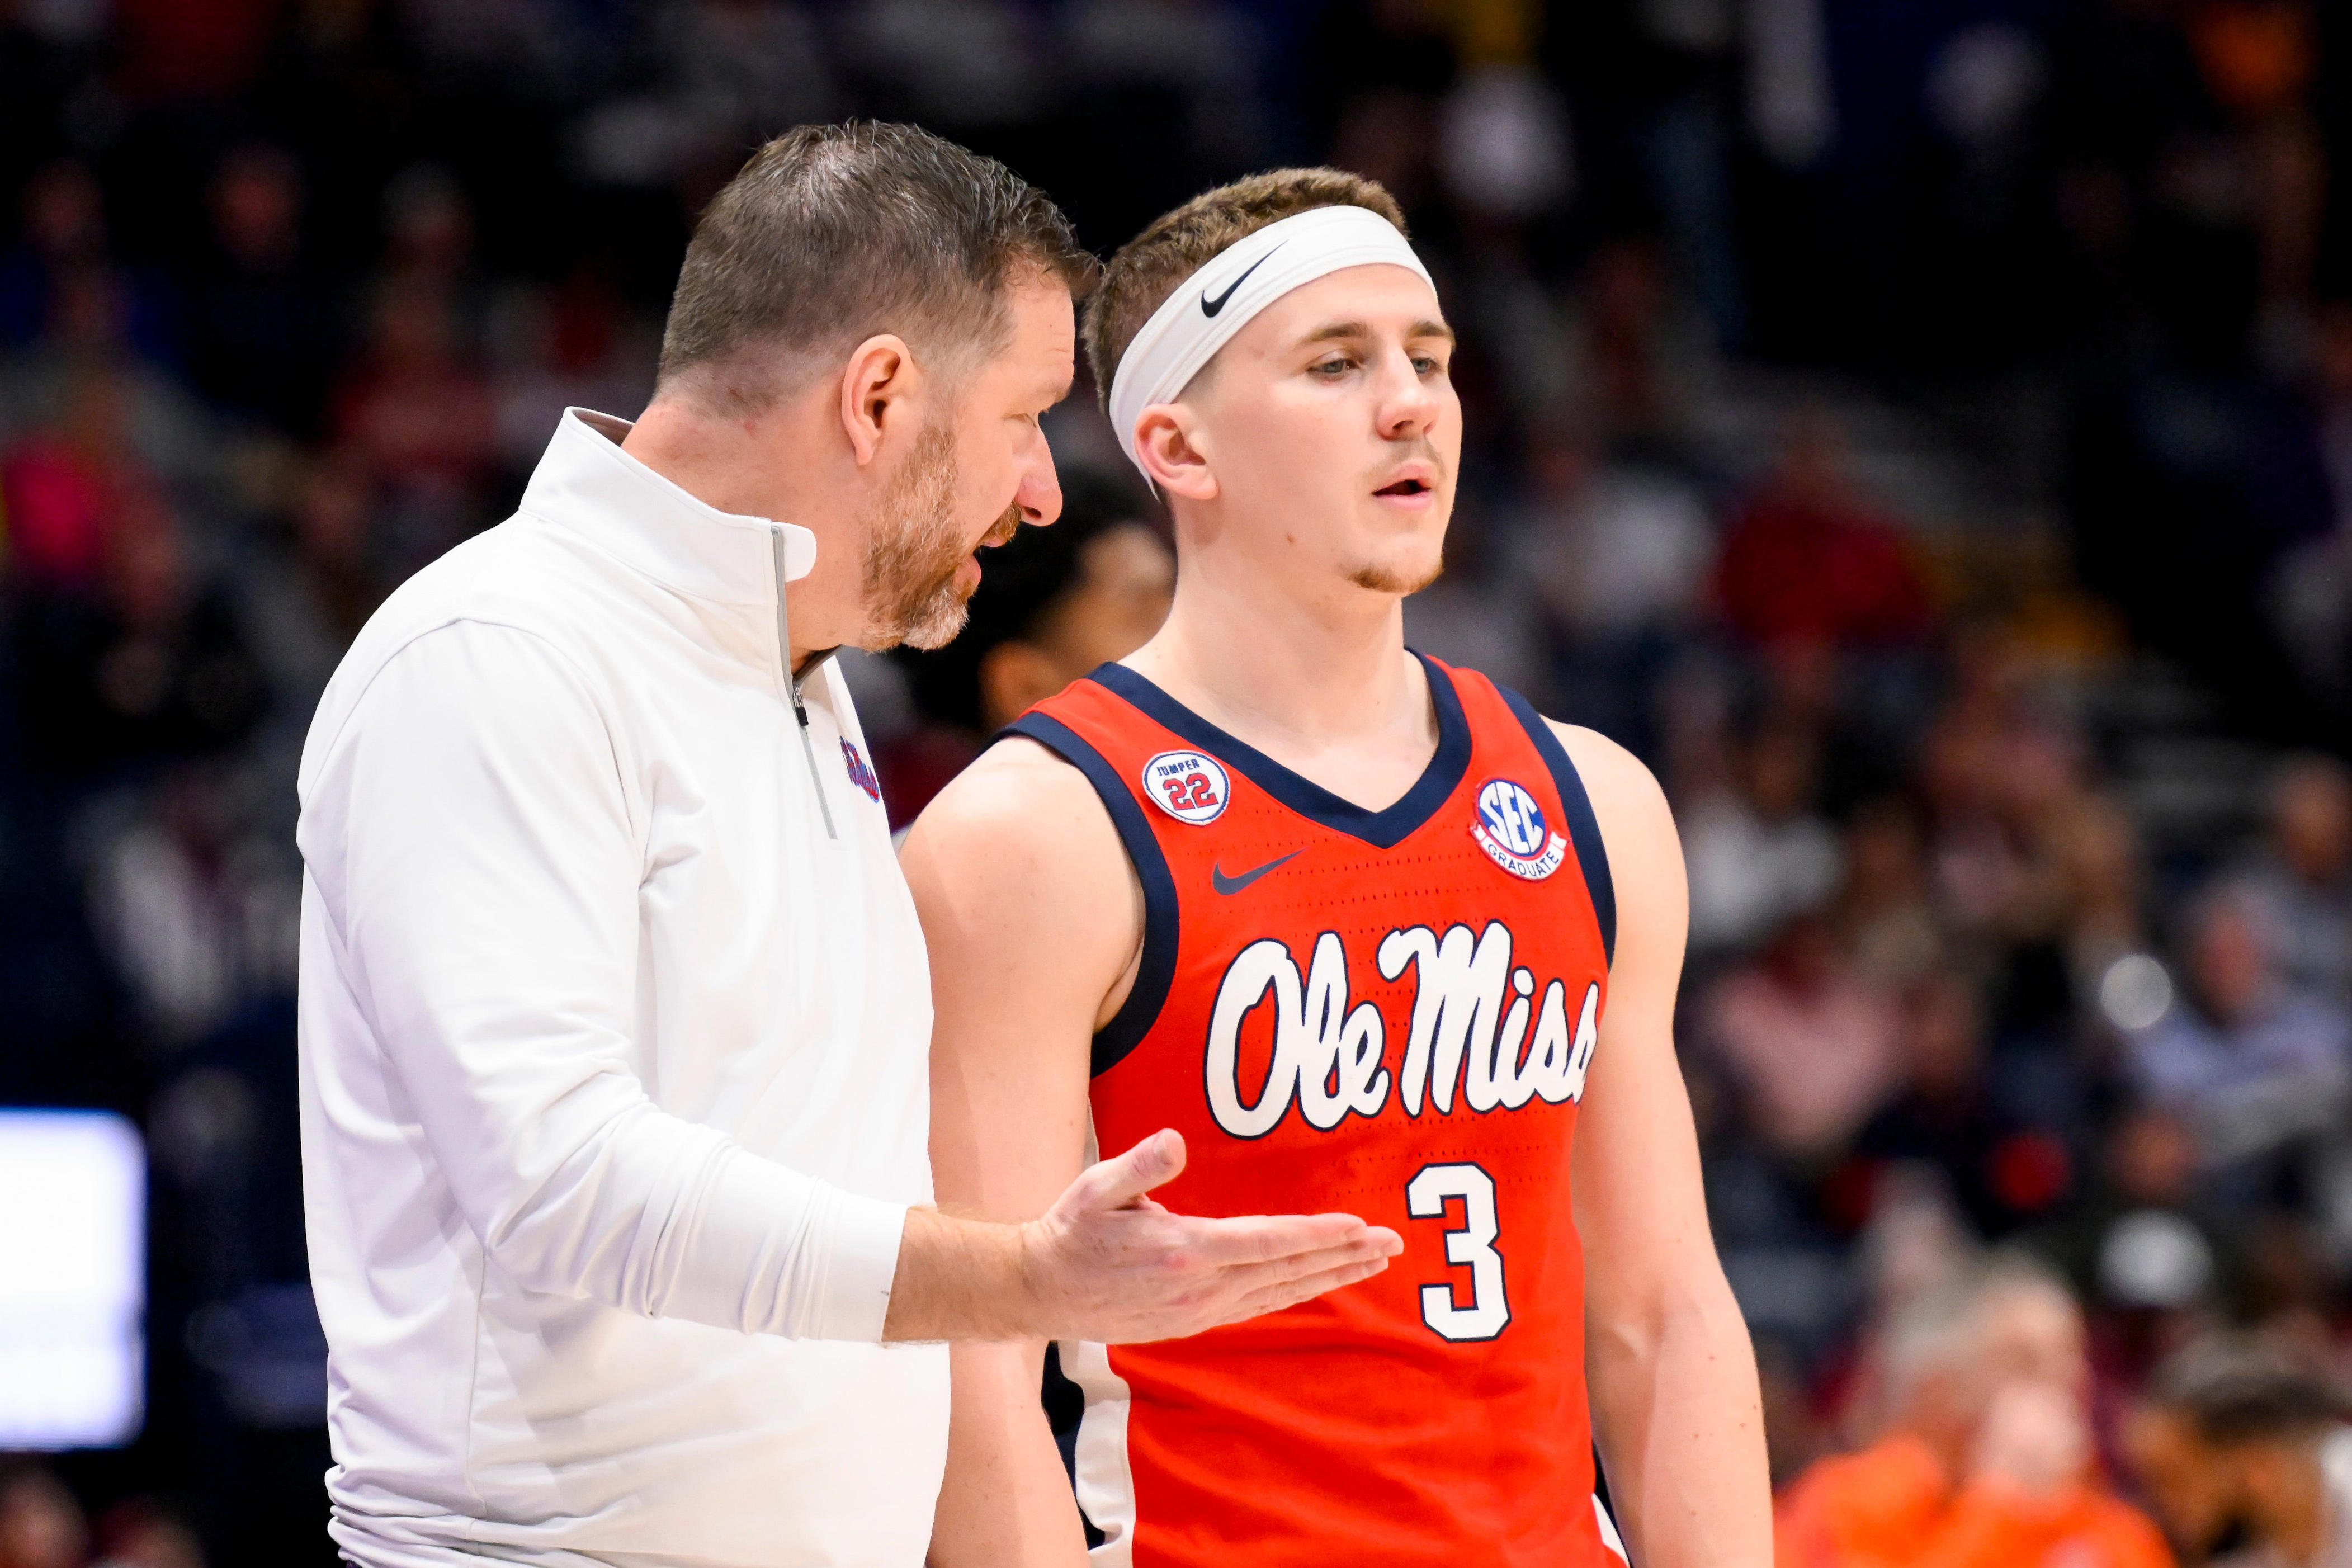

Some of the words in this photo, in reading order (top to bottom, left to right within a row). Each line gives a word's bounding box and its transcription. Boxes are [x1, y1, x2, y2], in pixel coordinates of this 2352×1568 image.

[1156, 758, 1200, 777] JUMPER
[1162, 772, 1220, 811] 22
[1479, 781, 1544, 854] SEC
[1487, 843, 1560, 877] GRADUATE
[1203, 930, 1392, 1140] Ole
[1376, 918, 1600, 1118] Miss
[1405, 1161, 1512, 1343] 3
